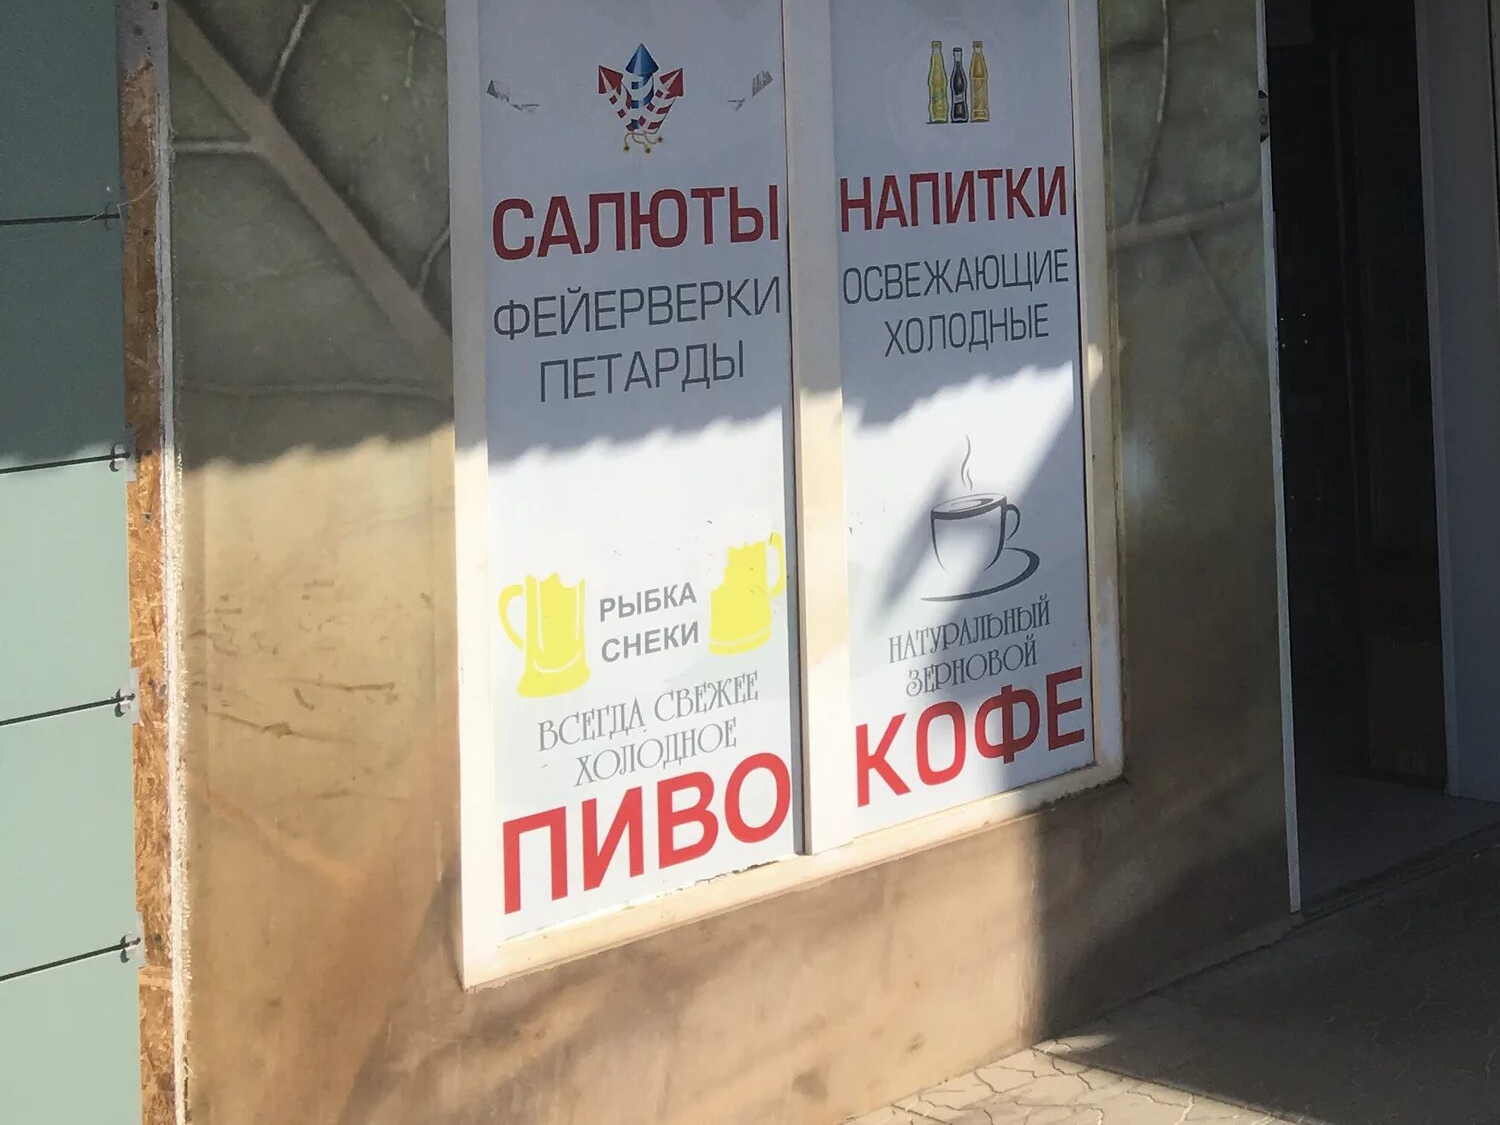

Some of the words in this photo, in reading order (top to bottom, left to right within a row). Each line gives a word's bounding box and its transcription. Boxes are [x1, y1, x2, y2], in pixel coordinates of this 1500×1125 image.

[492, 184, 779, 261] САЛЮТЫ
[840, 166, 1068, 233] НАПИТКИ
[493, 276, 781, 340] ФЕЙЕРВЕРКИ
[843, 248, 1069, 305] ОСВЕЖАЮЩИЕ
[883, 303, 1050, 357] ХОЛОДНЫЕ
[539, 340, 745, 403] ПЕТАРДЫ
[599, 581, 698, 623] РЫБКА
[888, 593, 1050, 664] НАТУРАЛЬНЫЙ
[601, 621, 699, 663] СНЕКИ
[906, 633, 1038, 697] ЗЕРНОВОЙ
[537, 697, 646, 752] ВСЕГДА
[654, 670, 759, 723] СВЕЖЕЕ
[856, 666, 1085, 808] КОФЕ
[574, 717, 738, 788] ХОЛОДНОЕ
[502, 751, 792, 915] ПИВО
